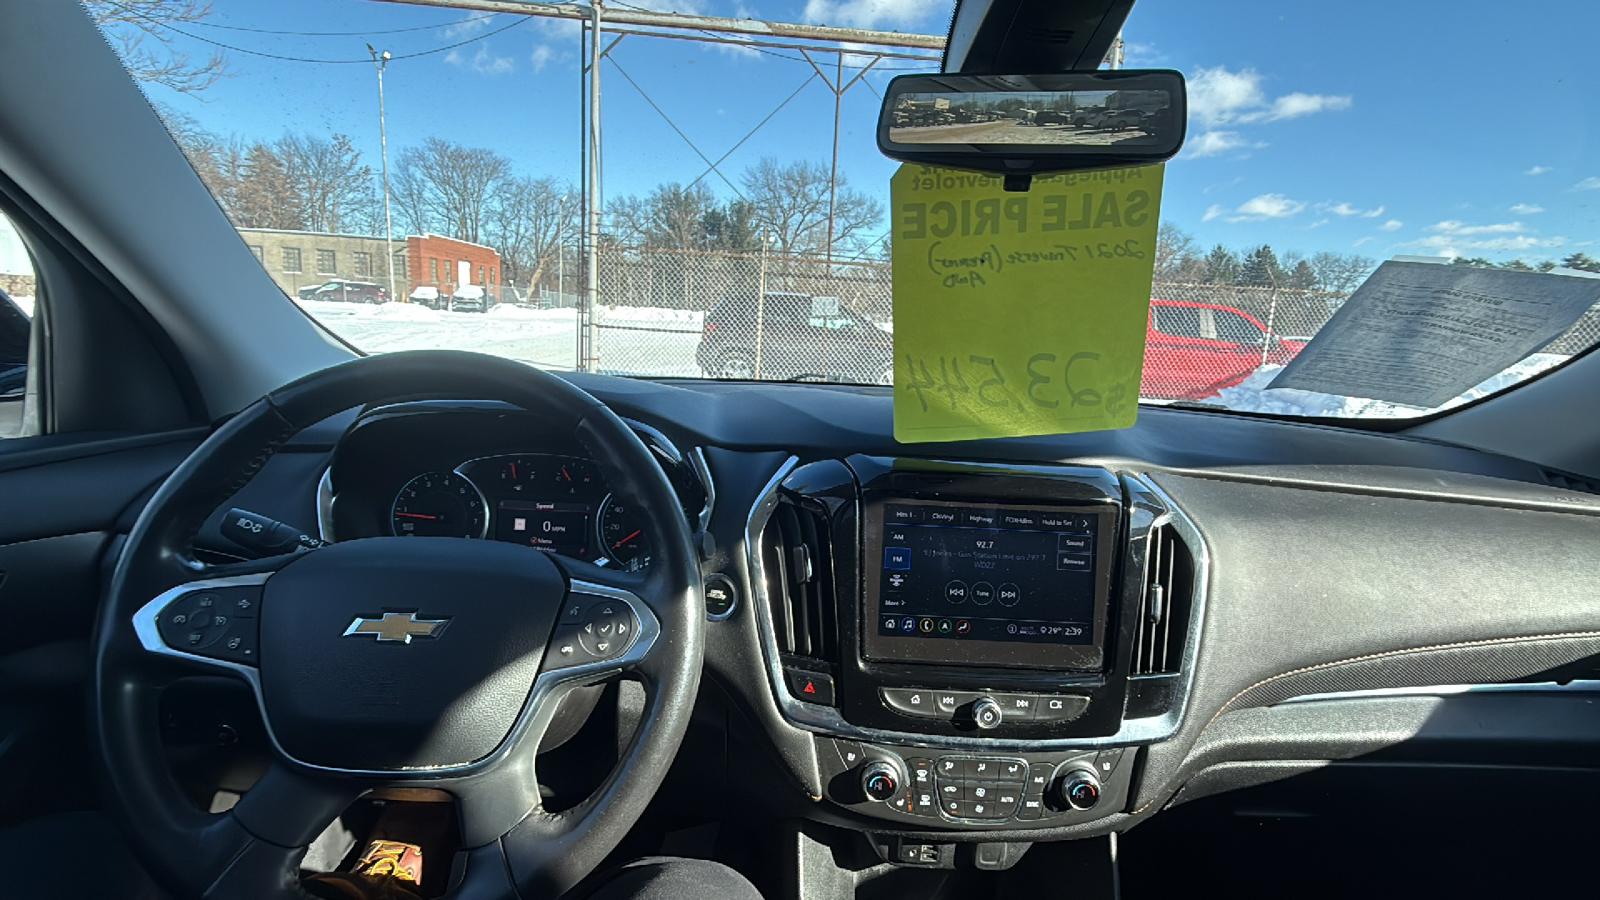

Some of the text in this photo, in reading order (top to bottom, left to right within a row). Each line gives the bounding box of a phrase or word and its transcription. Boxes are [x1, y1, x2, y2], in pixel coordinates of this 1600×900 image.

[614, 506, 624, 514] 40
[542, 520, 551, 532] 0
[976, 540, 994, 549] 92.7
[892, 555, 903, 563] FM
[1065, 626, 1083, 636] 2:39
